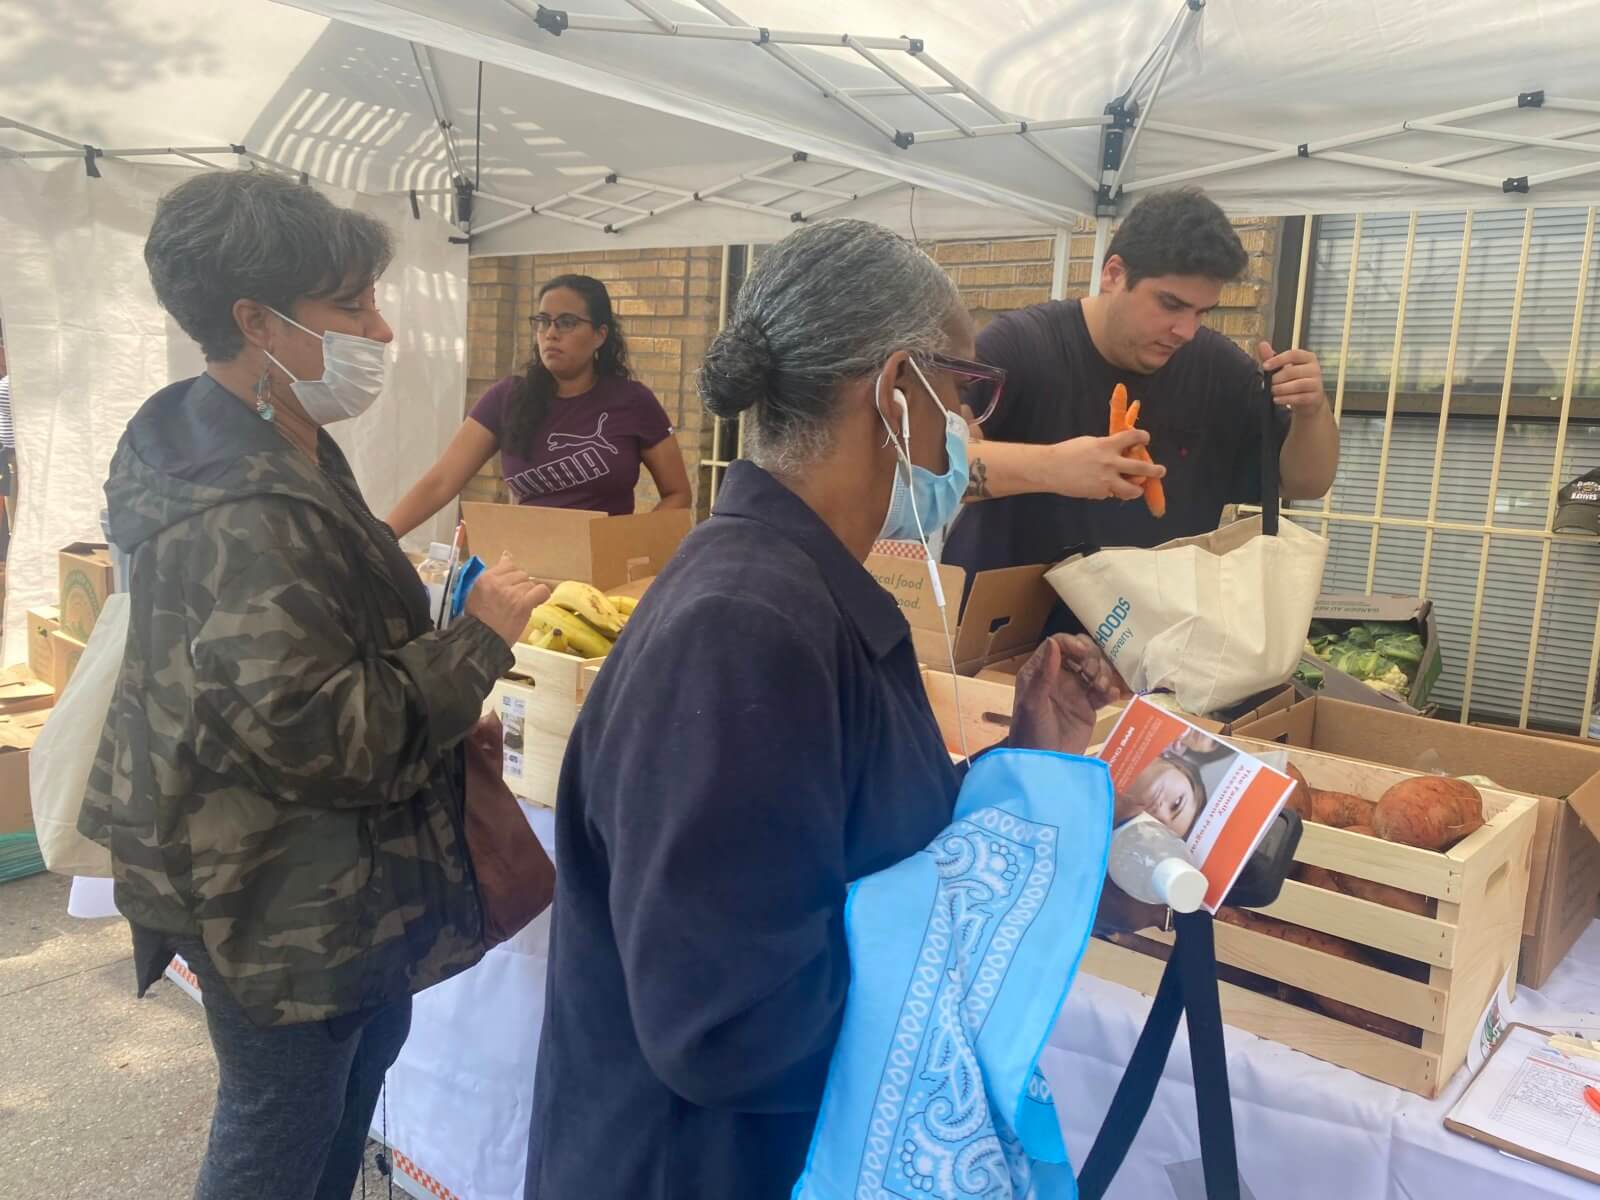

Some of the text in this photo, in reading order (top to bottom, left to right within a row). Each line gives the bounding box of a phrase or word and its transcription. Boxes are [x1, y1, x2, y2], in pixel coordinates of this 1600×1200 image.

[895, 573, 924, 590] food
[897, 597, 921, 609] ood.
[1095, 597, 1131, 648] HOODS
[1216, 767, 1251, 817] The Family
